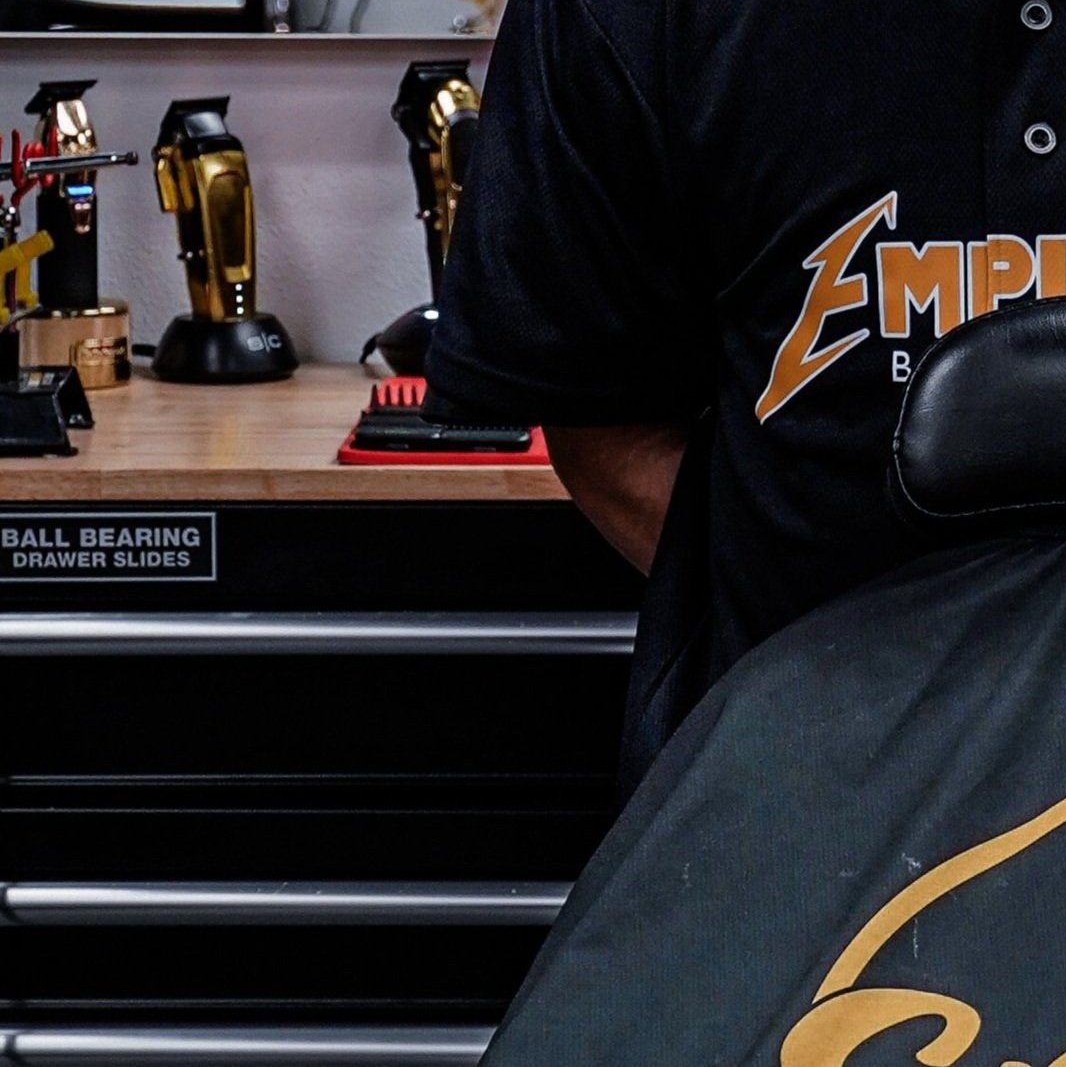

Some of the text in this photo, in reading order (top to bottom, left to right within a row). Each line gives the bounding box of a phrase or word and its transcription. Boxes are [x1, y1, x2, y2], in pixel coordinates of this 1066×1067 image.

[1, 527, 201, 548] BALL BEARING
[12, 551, 191, 568] DRAWER SLIDES
